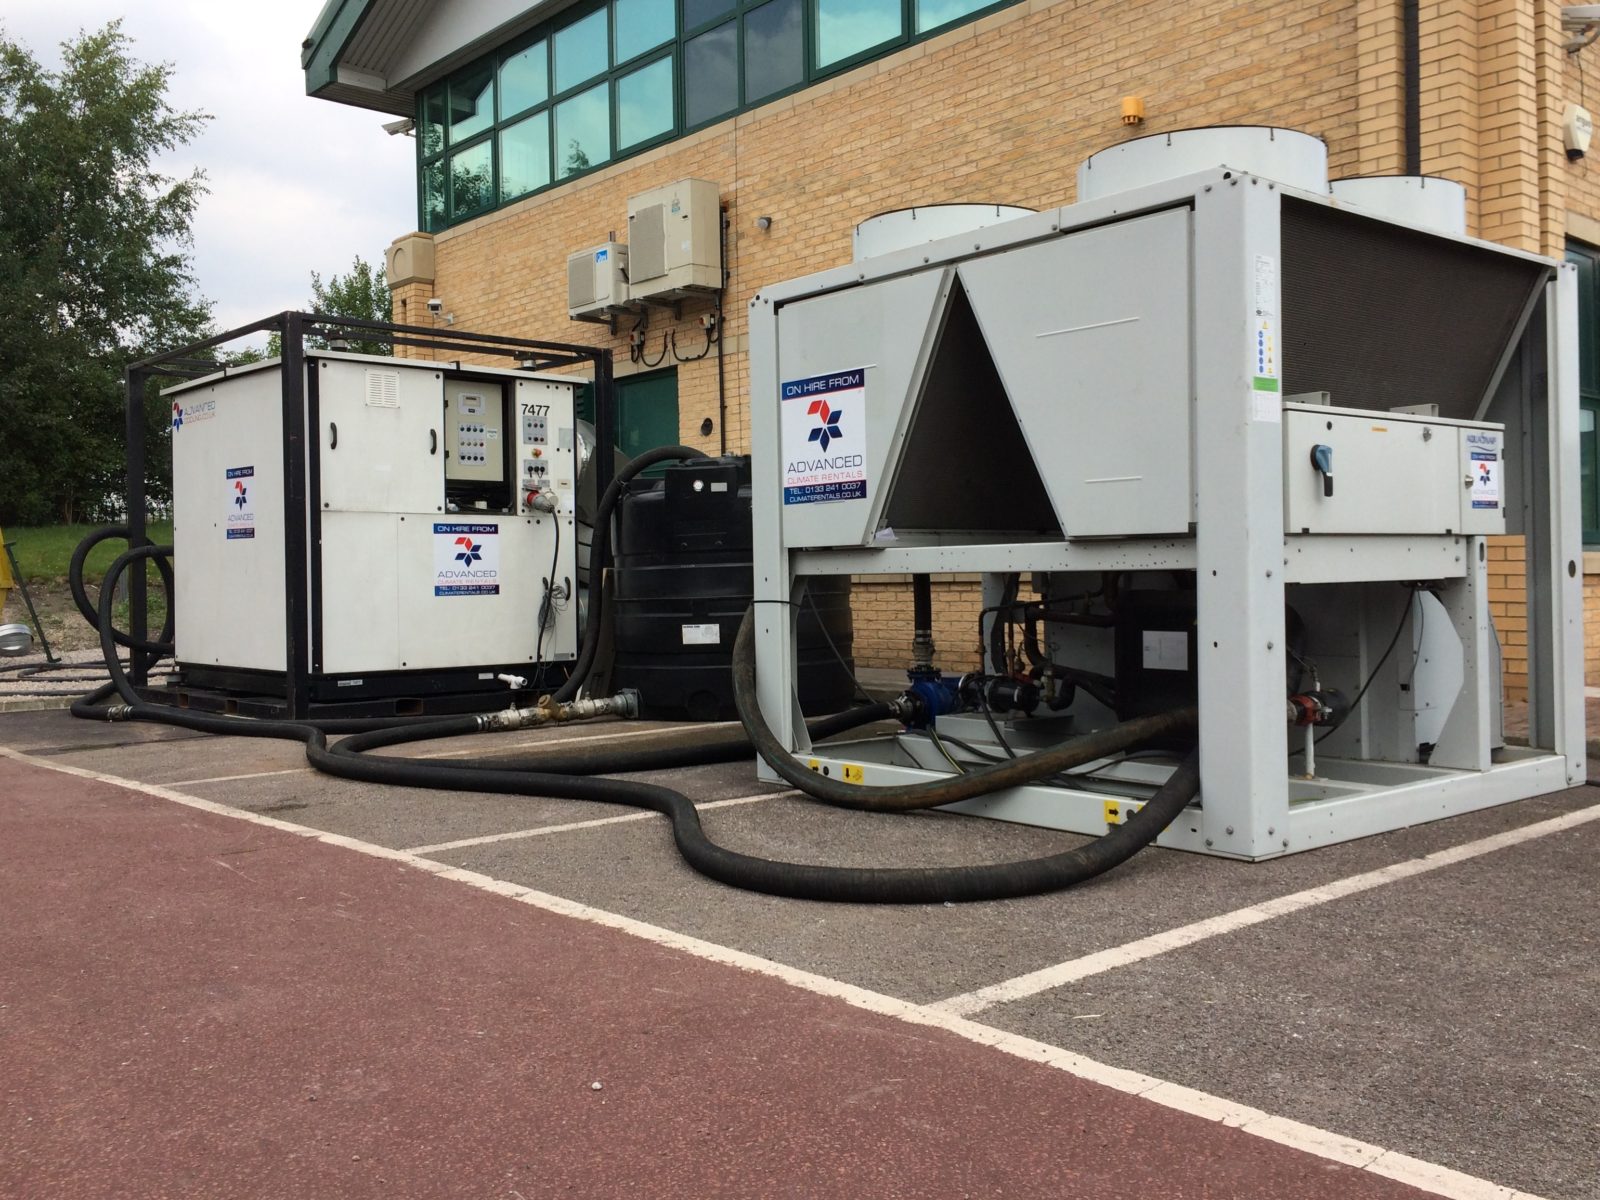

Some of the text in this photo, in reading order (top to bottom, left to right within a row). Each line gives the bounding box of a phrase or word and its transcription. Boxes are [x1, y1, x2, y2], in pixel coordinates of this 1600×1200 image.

[787, 374, 859, 395] ON HIRE FROM
[521, 403, 550, 416] 7477
[787, 454, 863, 474] ADVANCED
[787, 471, 863, 485] CLIMATE RENTALS
[805, 486, 824, 494] 0133
[825, 484, 839, 492] 241
[842, 482, 861, 490] 0037
[438, 570, 497, 578] ADVANCED
